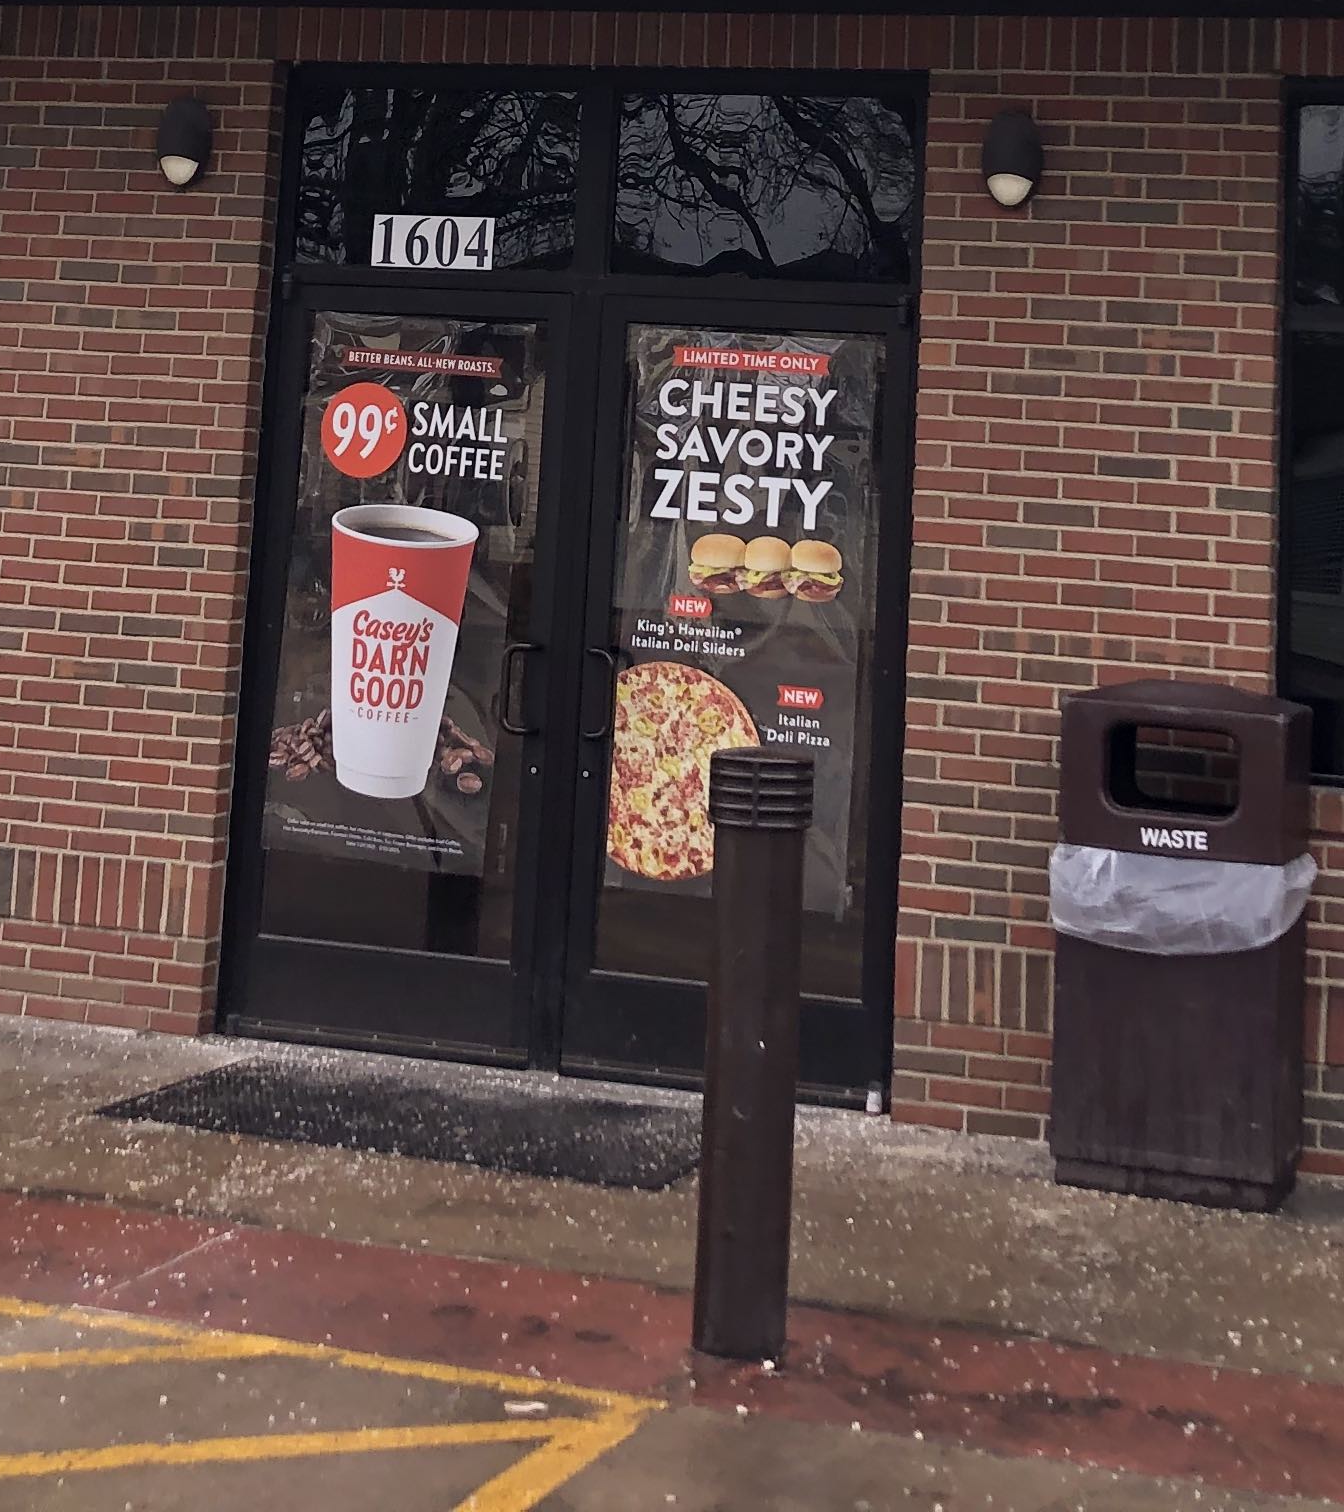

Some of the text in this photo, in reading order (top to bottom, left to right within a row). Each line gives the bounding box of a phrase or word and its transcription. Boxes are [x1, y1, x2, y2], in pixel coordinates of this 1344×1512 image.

[376, 216, 490, 268] 1604
[348, 350, 496, 373] BETTER BEANS. ALL-NEW ROASTS.
[682, 349, 819, 371] LIMITED TIME ONLY
[658, 378, 838, 426] CHEESY
[331, 401, 399, 460] 99¢
[411, 401, 508, 444] SMALL
[407, 442, 505, 481] COFFEE
[655, 423, 835, 471] SAVORY
[650, 467, 834, 531] ZESTY
[674, 598, 707, 614] NEW
[352, 609, 434, 649] Casey's
[631, 634, 746, 657] Italian Deli Sliders
[637, 619, 675, 636] King's
[351, 637, 430, 676] DARN
[350, 671, 424, 710] GOOD
[783, 689, 819, 705] NEW
[766, 728, 831, 747] Deli Pizza
[778, 713, 820, 730] Italian
[1139, 826, 1209, 851] WASTE
